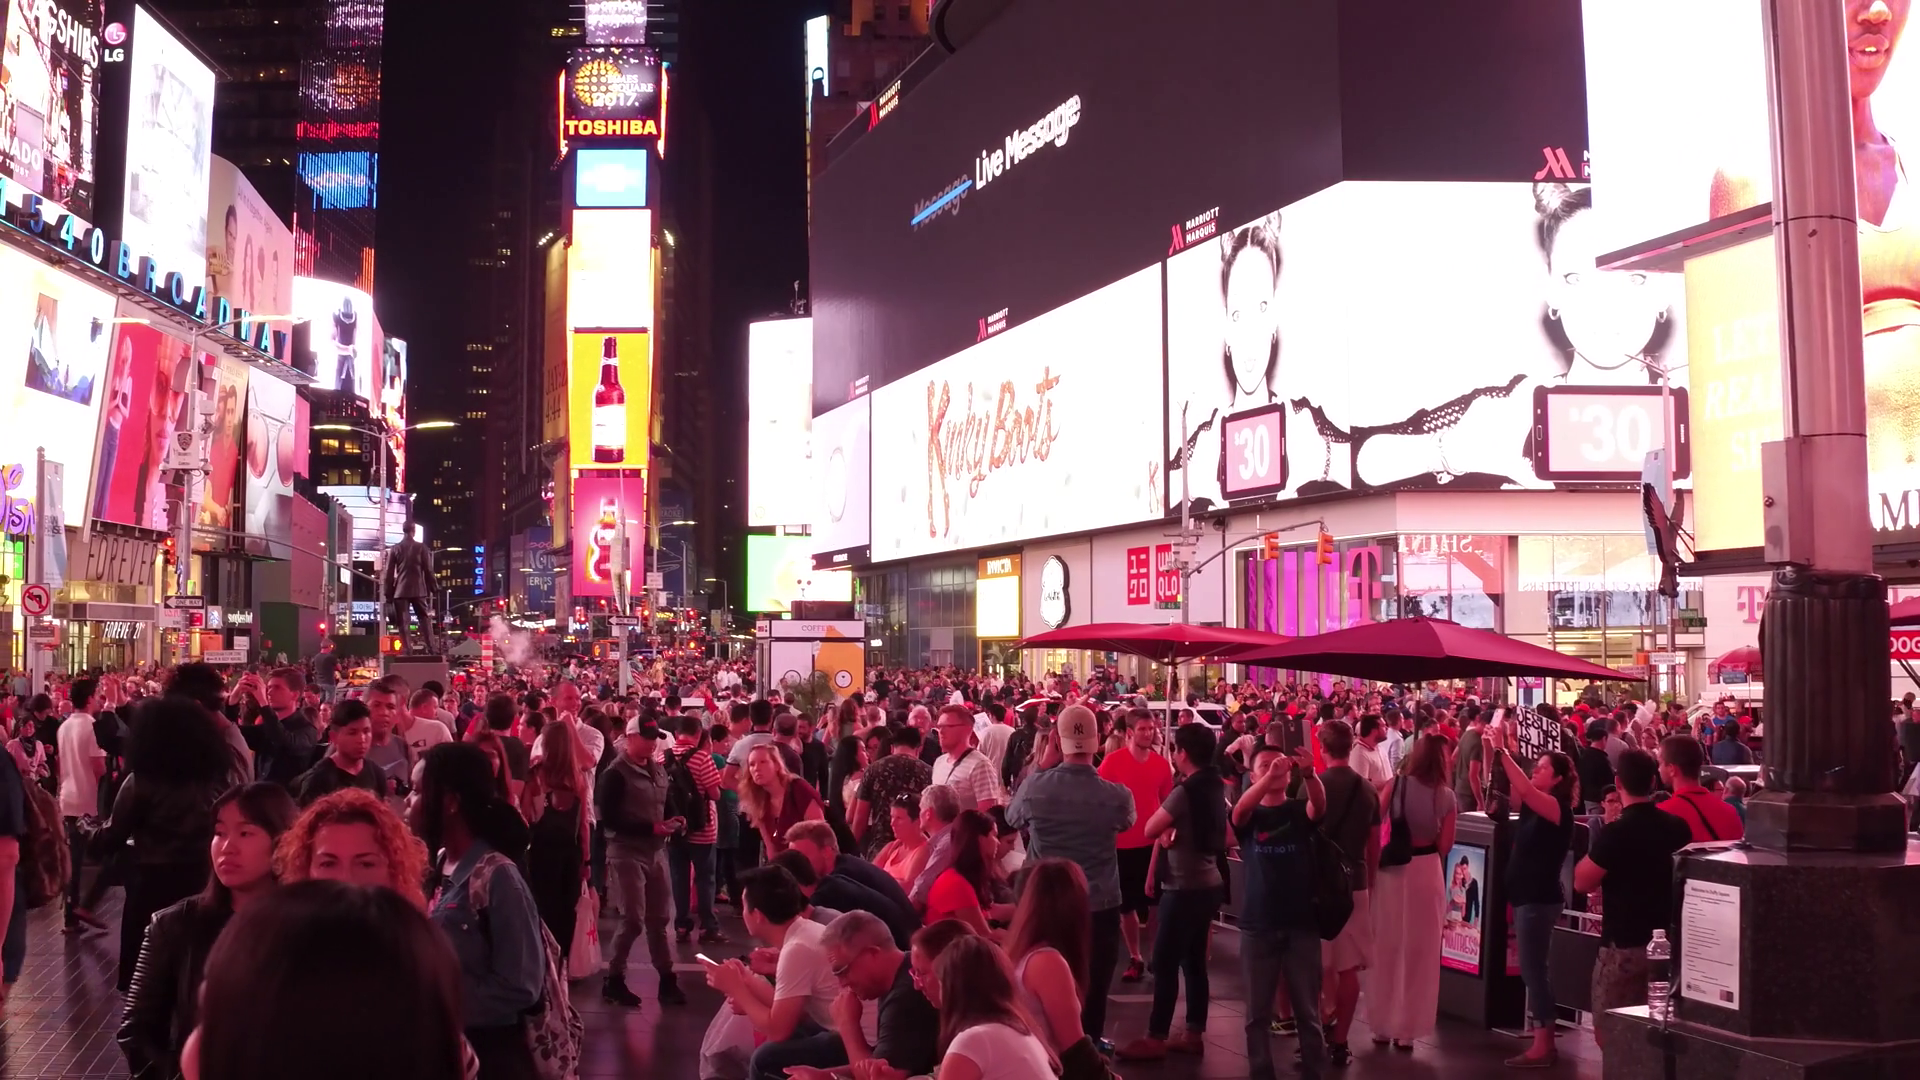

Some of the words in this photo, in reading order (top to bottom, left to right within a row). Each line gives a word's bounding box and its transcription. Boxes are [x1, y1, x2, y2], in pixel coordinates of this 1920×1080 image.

[104, 49, 124, 62] LG
[565, 120, 658, 135] TOSHIBA
[975, 149, 1003, 190] Live
[1005, 94, 1081, 170] Message
[1185, 206, 1219, 231] MARRIOTT
[1186, 222, 1216, 243] MARQUIS
[117, 240, 288, 360] BROADWAY
[86, 532, 158, 586] FOREVER
[1157, 575, 1178, 600] QLO
[1517, 708, 1560, 740] JESUS
[1519, 721, 1532, 742] IS
[1537, 730, 1560, 752] LIFE
[1255, 845, 1273, 853] JUST
[1274, 845, 1285, 853] DO
[1287, 844, 1296, 852] IT
